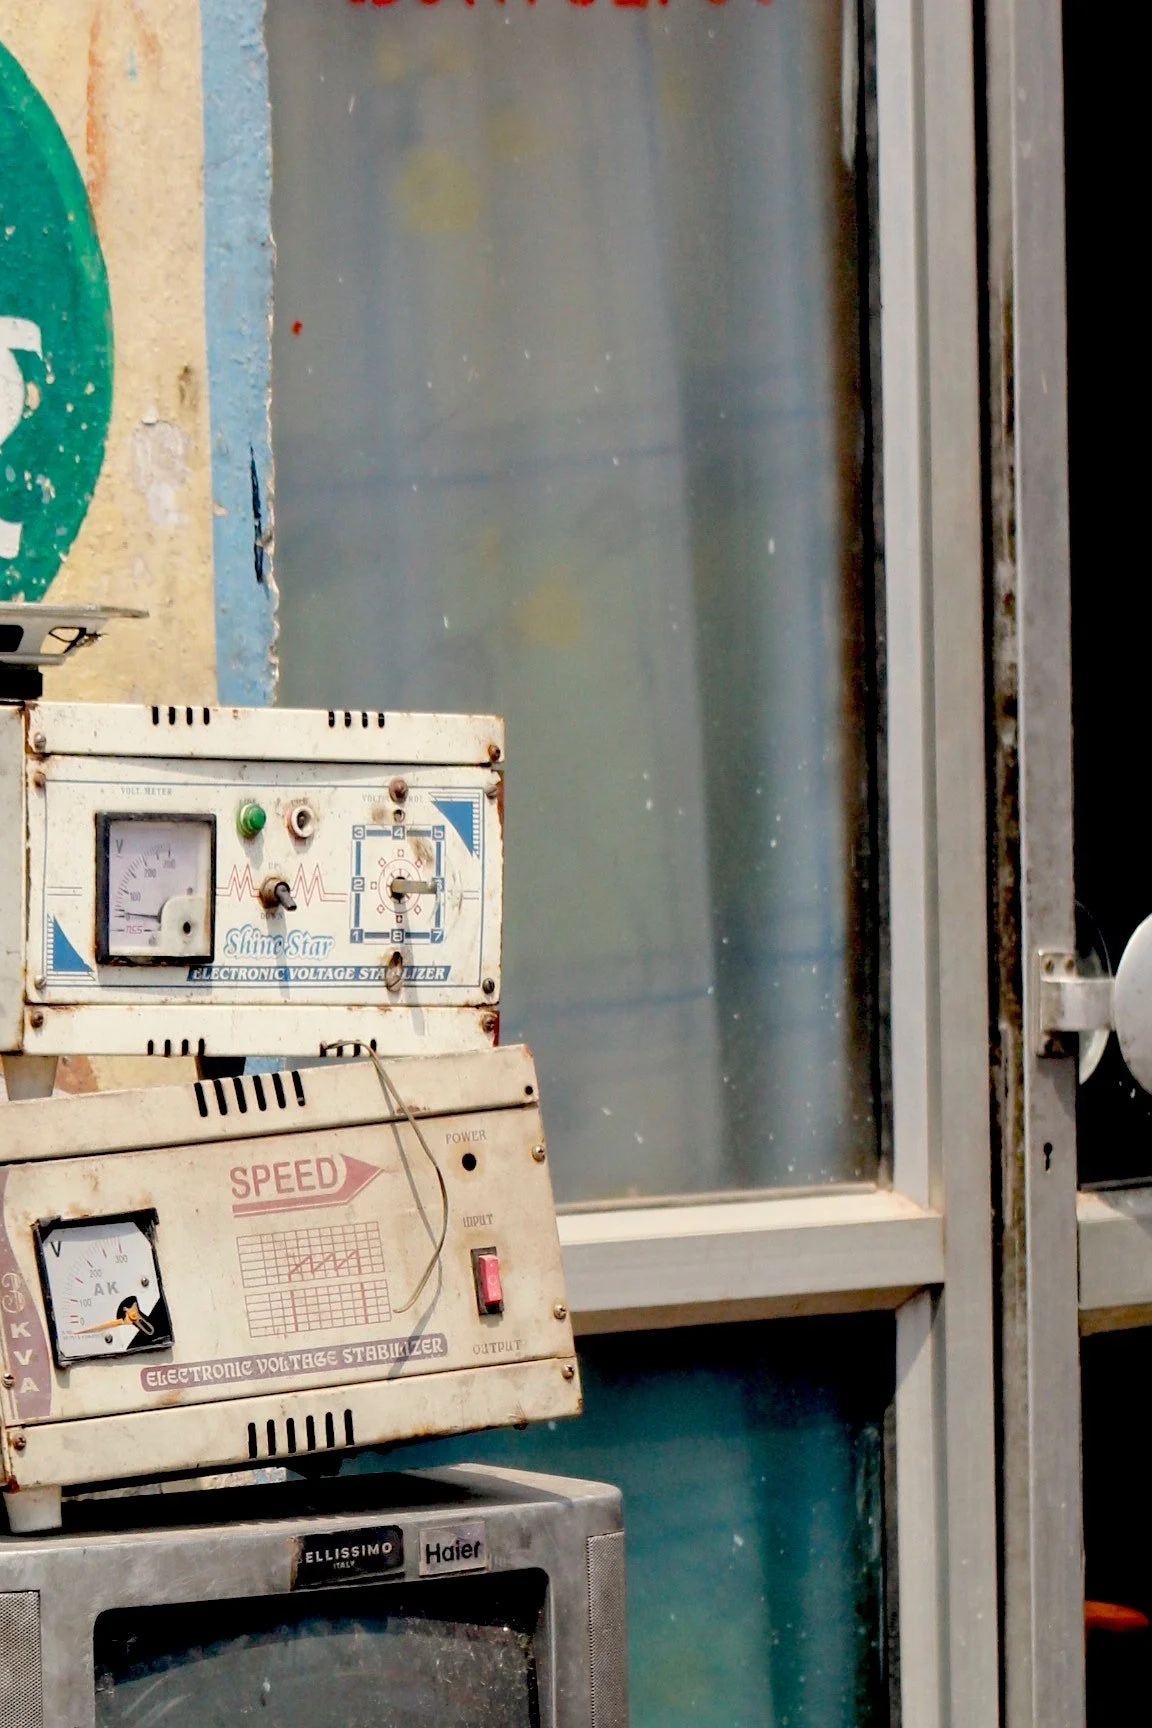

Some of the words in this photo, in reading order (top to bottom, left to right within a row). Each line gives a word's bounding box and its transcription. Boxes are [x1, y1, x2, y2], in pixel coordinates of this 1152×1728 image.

[120, 787, 140, 796] VOLT
[144, 787, 173, 796] METER
[354, 827, 364, 838] 3
[393, 827, 405, 839] 4
[434, 827, 445, 839] 5
[116, 839, 123, 854] V
[352, 879, 364, 891] 2
[225, 927, 285, 960] Shine
[285, 929, 336, 960] Star
[352, 931, 363, 943] 1
[391, 931, 404, 943] 8
[432, 931, 443, 943] 7
[193, 967, 285, 981] ELECTRONIC
[288, 967, 356, 981] VOLTAGE
[359, 967, 446, 982] STALIZER
[446, 1130, 488, 1144] POWER
[229, 1157, 338, 1199] SPEED
[463, 1213, 494, 1228] INPUT
[50, 1241, 62, 1257] V
[115, 1254, 128, 1264] 300
[89, 1269, 102, 1278] 200
[79, 1299, 92, 1308] 100
[473, 1339, 522, 1355] OUTPUT
[146, 1361, 252, 1386] ELECTRONIC
[256, 1350, 338, 1373] VOLTAGE
[343, 1338, 443, 1363] STABILIZER
[300, 1542, 393, 1564] ELLISSIMO
[426, 1542, 480, 1565] Haier
[333, 1561, 355, 1569] ITALY
